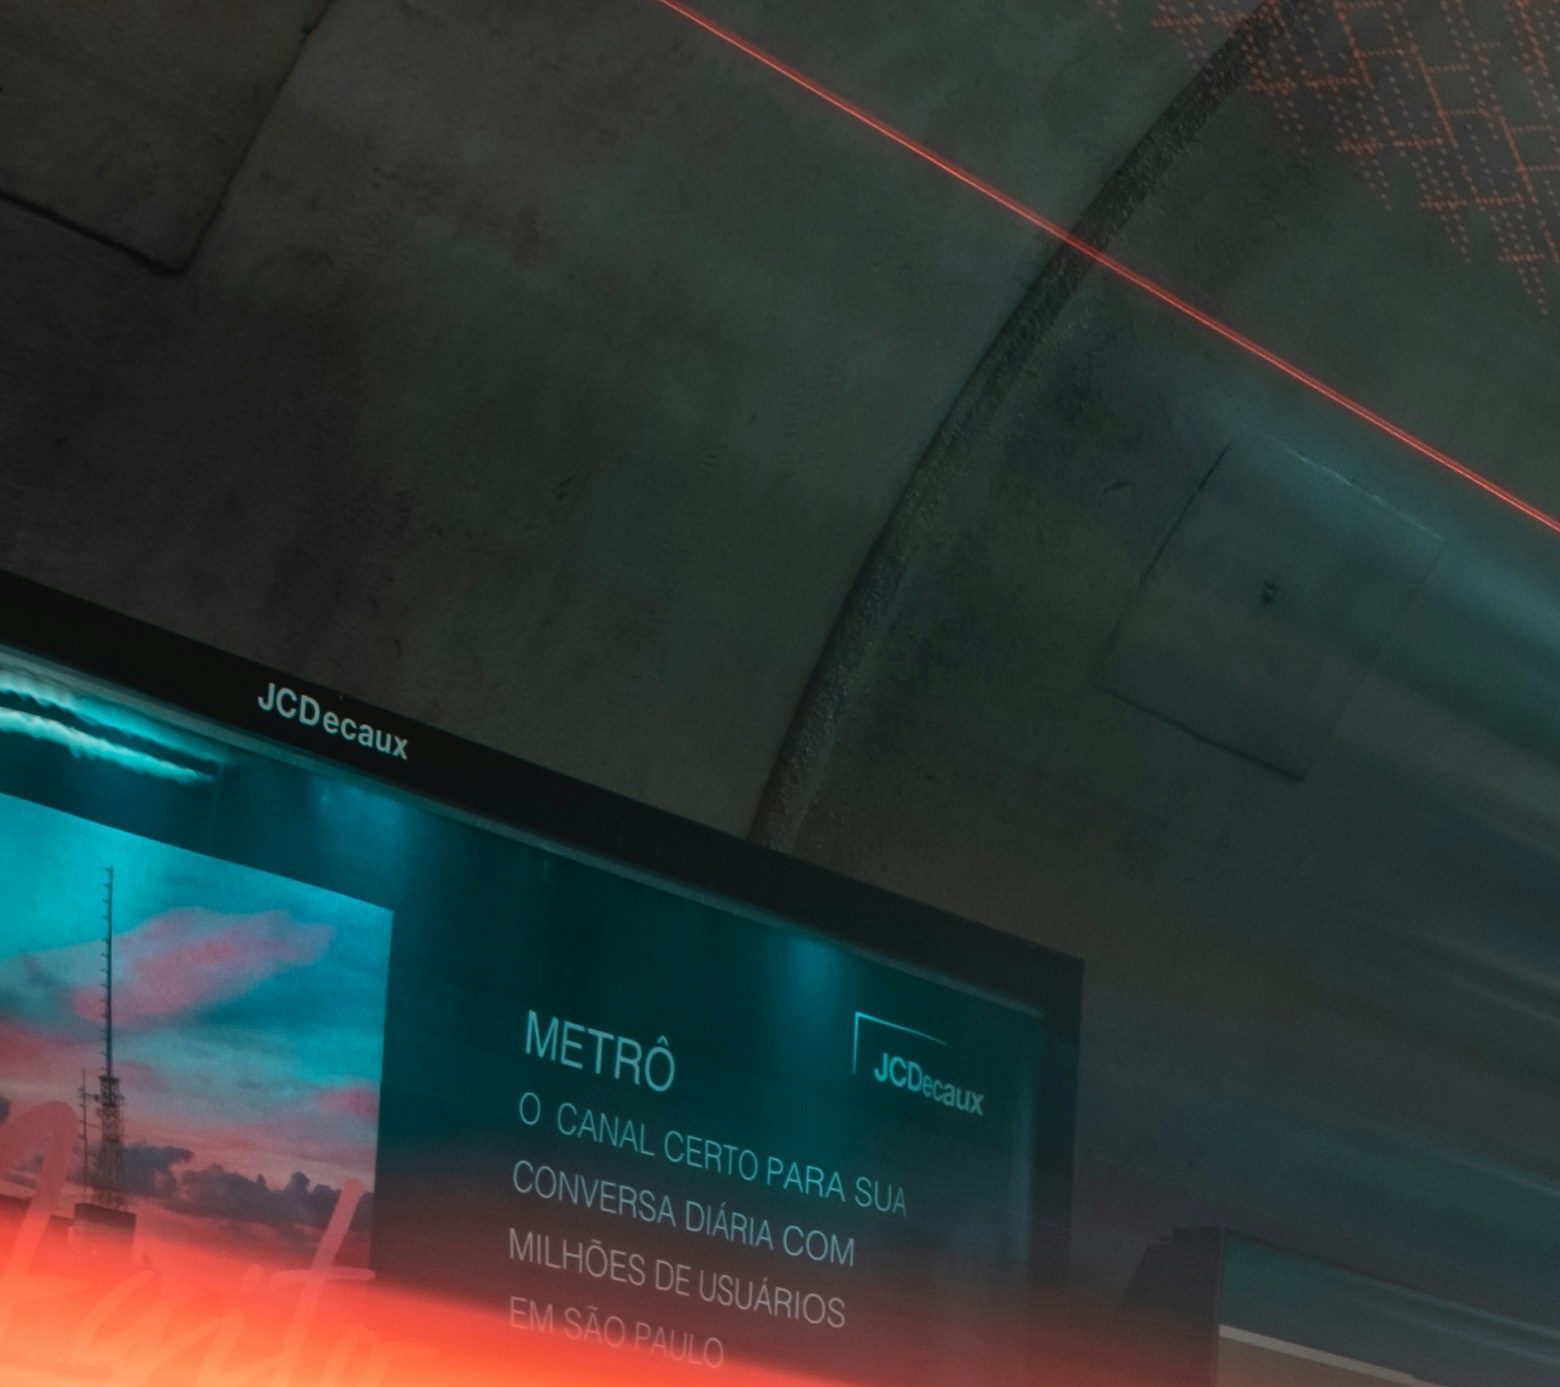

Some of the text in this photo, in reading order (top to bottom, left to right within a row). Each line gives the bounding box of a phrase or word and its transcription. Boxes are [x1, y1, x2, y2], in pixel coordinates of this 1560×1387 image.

[257, 682, 409, 761] JCDecaux
[525, 1009, 675, 1092] METRÔ
[873, 1053, 985, 1116] JCDecaux
[519, 1092, 907, 1217] O CANAL CERTO PARA SUA
[513, 1160, 855, 1267] CONVERSA DIÁRIA COM
[508, 1228, 846, 1328] MILHÕES DE USUÁRIOS
[509, 1296, 724, 1368] EM SÃO PAULO
